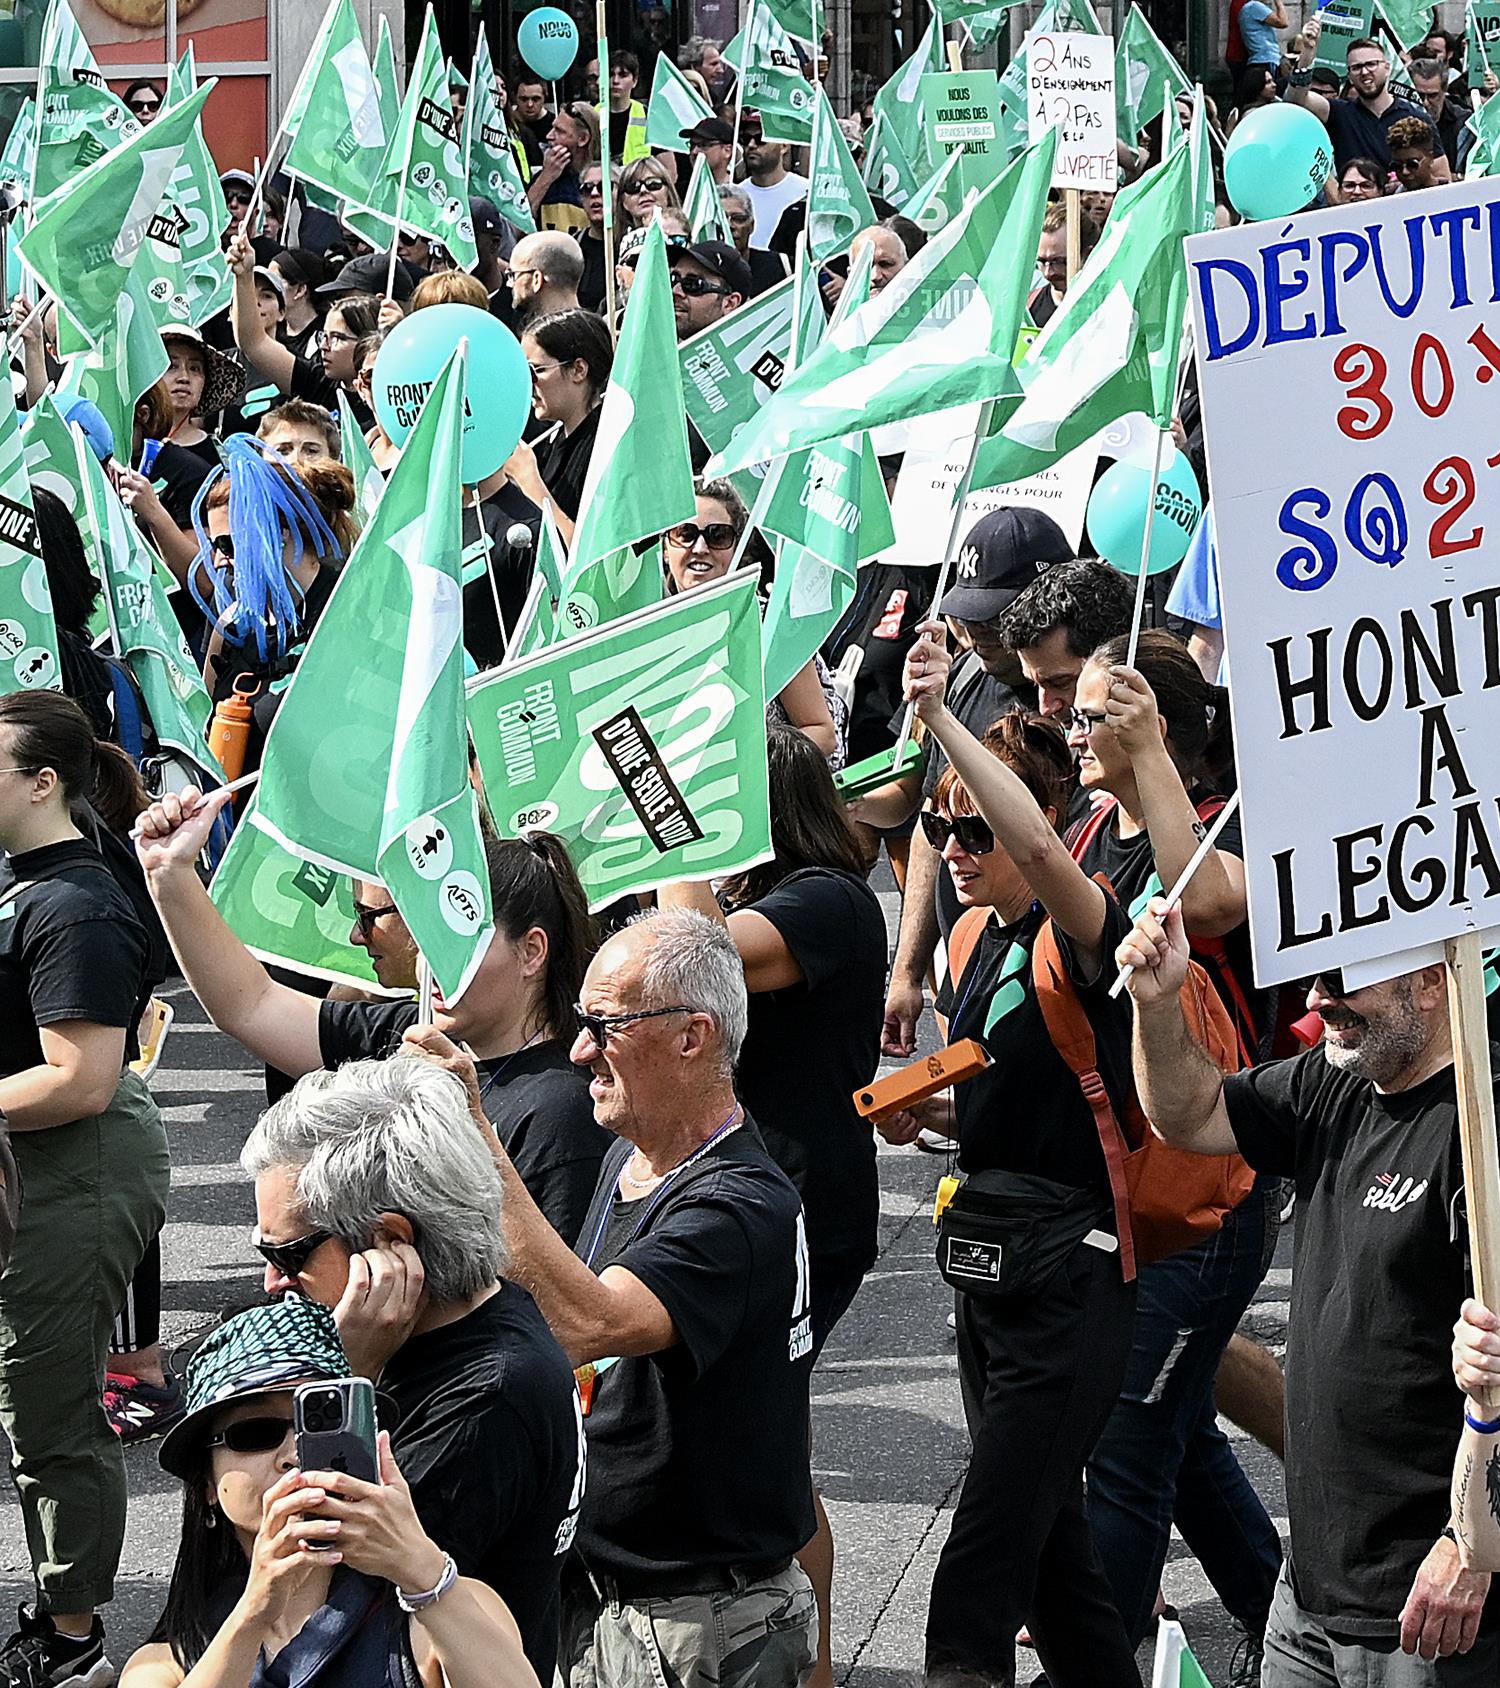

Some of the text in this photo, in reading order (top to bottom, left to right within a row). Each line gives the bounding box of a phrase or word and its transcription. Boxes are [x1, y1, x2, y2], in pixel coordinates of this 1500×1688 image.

[1033, 36, 1058, 73] 2
[948, 88, 970, 101] NOUS
[421, 104, 450, 131] D'UNE
[936, 106, 989, 122] VOULONS DES
[1074, 104, 1103, 129] PAS
[482, 128, 507, 148] D'UNE
[694, 338, 732, 383] FRONT
[386, 380, 433, 406] FRONT
[683, 355, 729, 414] COMMUN
[802, 448, 848, 491] FRONT
[799, 477, 862, 535] COMMUN
[1024, 488, 1063, 500] POUR
[1275, 472, 1409, 592] SQ
[567, 601, 587, 630] APTS
[5, 630, 24, 649] CSQ
[523, 679, 562, 747] FRONT
[496, 699, 537, 789] COMMUN
[1416, 703, 1477, 809] A
[601, 716, 695, 848] D'UNE SEULE VOIX
[446, 884, 478, 922] APTS
